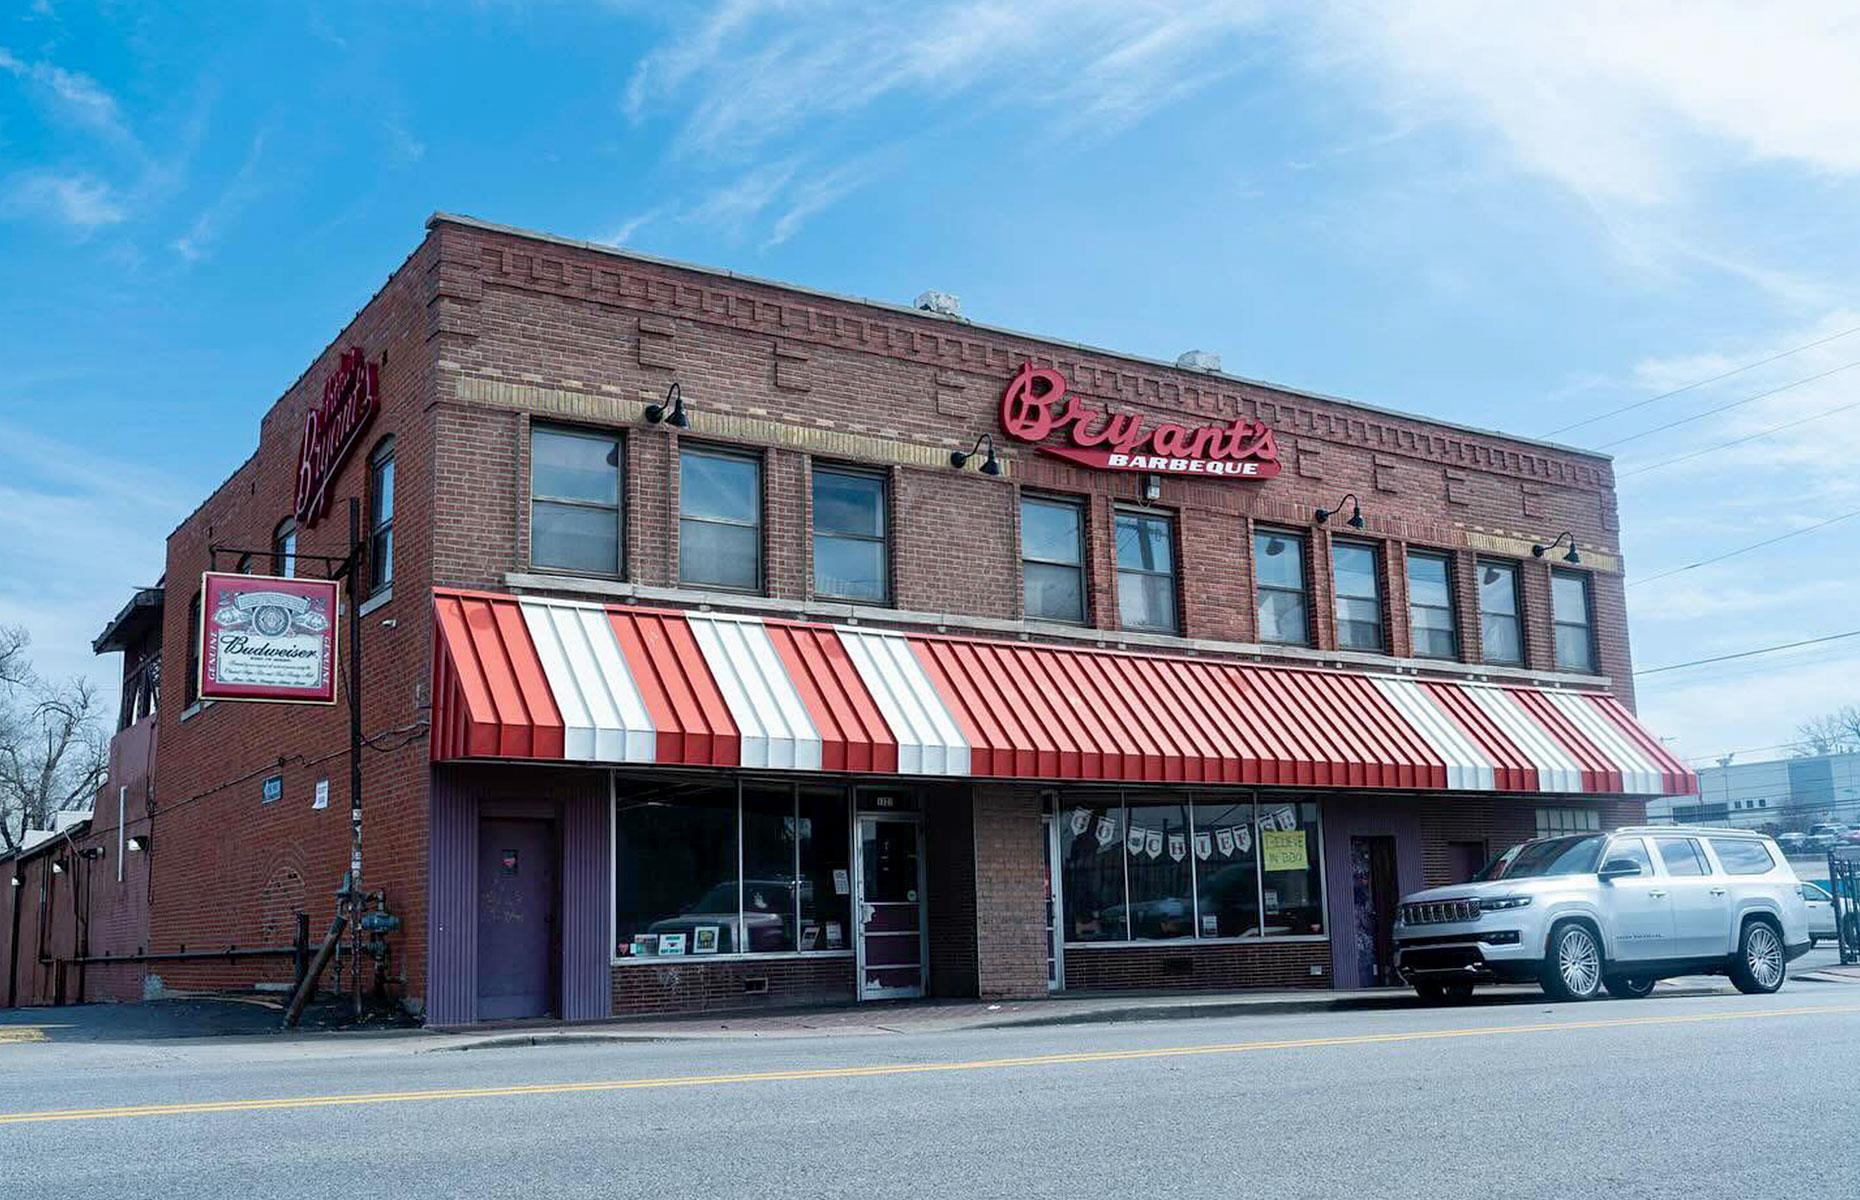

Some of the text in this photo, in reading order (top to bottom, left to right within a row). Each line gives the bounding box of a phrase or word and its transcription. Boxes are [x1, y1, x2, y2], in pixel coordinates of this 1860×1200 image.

[1002, 360, 1279, 460] Bryant's
[1108, 454, 1258, 475] BARBEQUE
[208, 631, 218, 681] GENUINE
[220, 635, 317, 659] Budweiser
